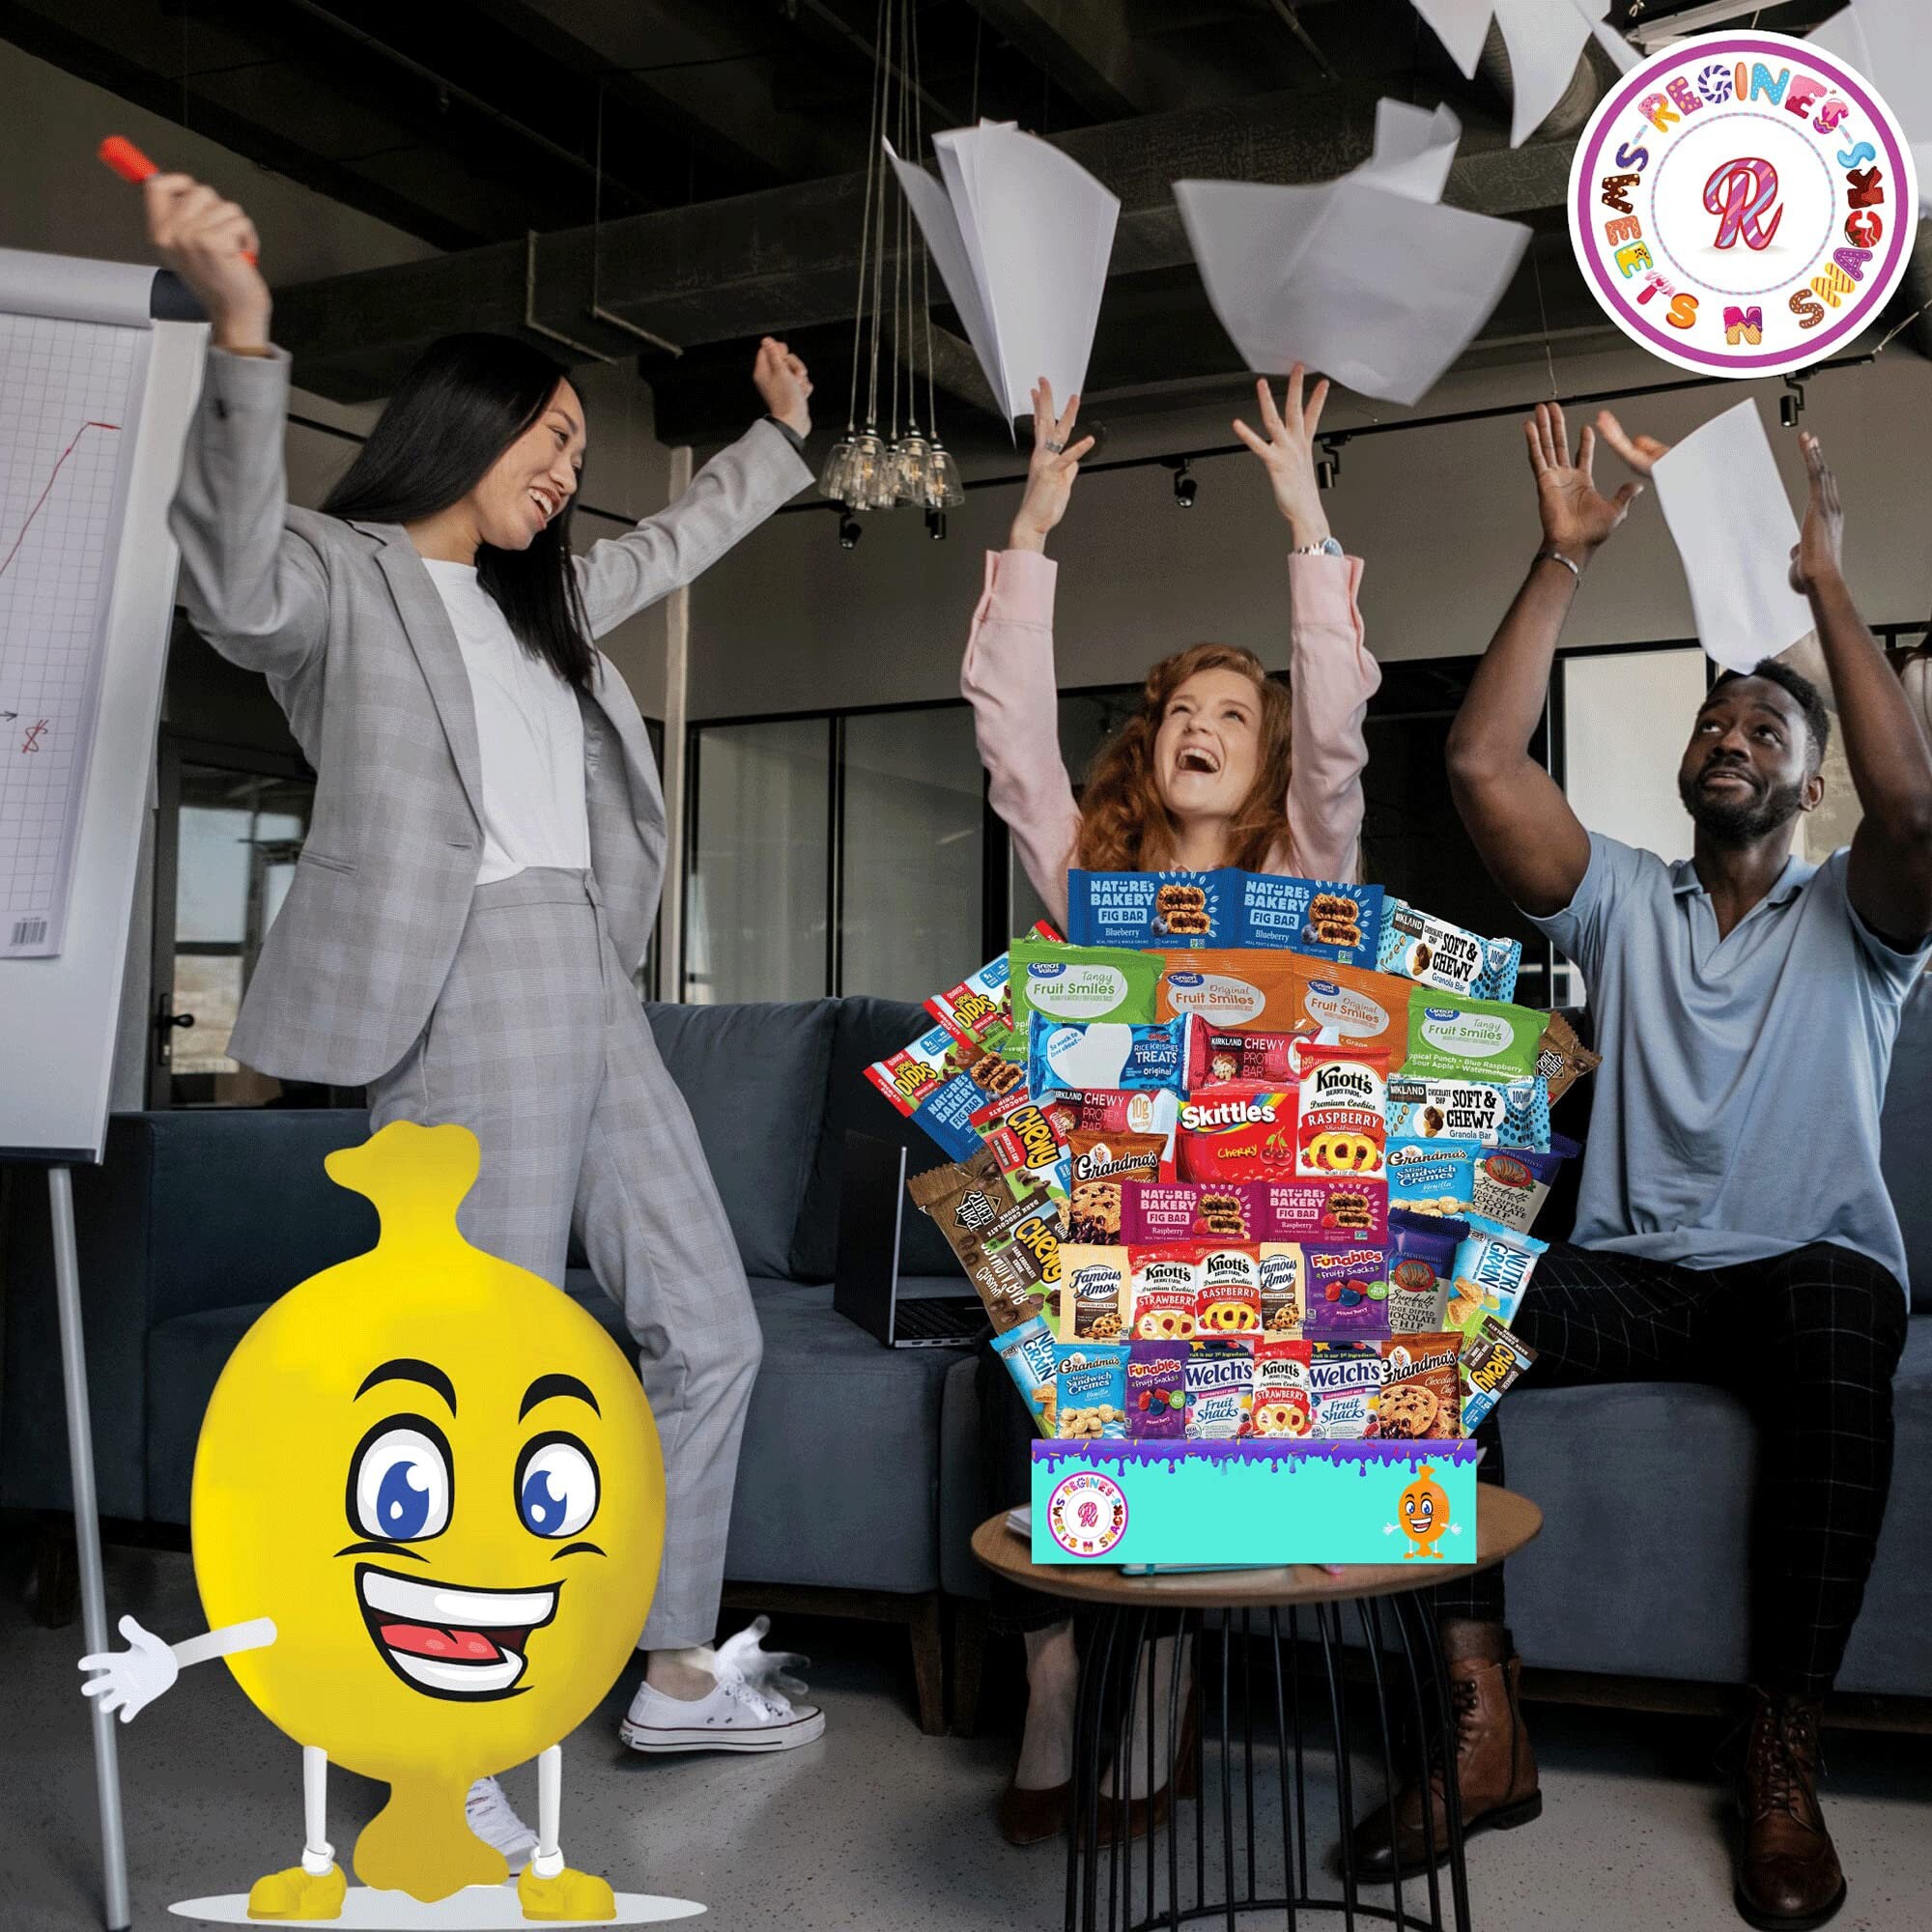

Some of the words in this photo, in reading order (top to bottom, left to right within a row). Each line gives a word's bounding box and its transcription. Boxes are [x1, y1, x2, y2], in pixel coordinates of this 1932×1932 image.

[21, 720, 49, 753] $
[1091, 894, 1153, 906] BAKERY
[1244, 894, 1309, 913] BAKERY
[1101, 911, 1119, 921] FIG
[1123, 911, 1144, 921] BAR
[1253, 912, 1272, 923] FIG
[1272, 915, 1295, 927] BAR
[1105, 927, 1140, 938] Blueberry
[1255, 929, 1290, 943] Blueberry
[1440, 933, 1468, 958] SOFT
[1466, 943, 1478, 962] &
[1433, 952, 1474, 981] CHEWY
[1082, 971, 1113, 985] Tangy
[1432, 972, 1454, 988] Granola
[1455, 981, 1466, 993] Bar
[1034, 983, 1065, 995] Fruit
[1067, 983, 1116, 995] Smiles
[1210, 984, 1249, 996] Original
[1176, 992, 1206, 1004] Fruit
[1209, 993, 1255, 1006] Smiles
[1343, 997, 1378, 1013] Original
[952, 994, 997, 1029] DIPPS
[1311, 998, 1338, 1012] Fruit
[1340, 1005, 1379, 1024] Smiles
[1429, 1024, 1457, 1037] Fruit
[1460, 1027, 1502, 1040] Smiles
[1473, 1018, 1501, 1032] Tangy
[1150, 1043, 1179, 1053] KRISPIES
[1211, 1037, 1242, 1046] KIRKLAND
[1244, 1037, 1285, 1050] CHEWY
[1135, 1051, 1179, 1065] TREATS
[1432, 1061, 1454, 1069] Apple
[1434, 1054, 1457, 1064] Punch
[1464, 1058, 1482, 1066] Blue
[1483, 1061, 1523, 1073] Raspberry
[894, 1062, 937, 1096] DIPPS
[1243, 1065, 1264, 1078] BAR
[1316, 1065, 1373, 1094] Knott's
[935, 1081, 977, 1123] BAKERY
[1084, 1093, 1124, 1108] CHEWY
[1310, 1099, 1346, 1110] Premium
[1347, 1098, 1376, 1110] Cookies
[1452, 1090, 1483, 1109] SOFT
[1484, 1091, 1497, 1109] &
[952, 1110, 969, 1126] FIG
[966, 1098, 980, 1116] BAR
[1131, 1096, 1150, 1120] 10g
[1181, 1100, 1276, 1130] Skittles
[1308, 1112, 1379, 1128] RASPBERRY
[1446, 1110, 1495, 1129] CHEWY
[1449, 1129, 1478, 1139] Granola
[1479, 1131, 1492, 1140] Bar
[1074, 1151, 1159, 1180] Grandma's
[1387, 1150, 1467, 1166] Grandma's
[1396, 1164, 1456, 1179] Sandwich
[1399, 1173, 1454, 1187] Cremes
[1141, 1200, 1197, 1210] BAKERY
[1270, 1198, 1325, 1208] BAKERY
[1472, 1201, 1511, 1218] CHIP
[1495, 1197, 1525, 1211] DIPPED
[1168, 1214, 1187, 1223] BAR
[1279, 1209, 1294, 1218] FIG
[1296, 1209, 1316, 1218] BAR
[1152, 1227, 1184, 1236] Raspberry
[1208, 1254, 1250, 1274] Knott's
[1312, 1250, 1383, 1268] Funables
[1477, 1241, 1509, 1289] GRAIN
[1069, 1269, 1122, 1289] Famous
[1146, 1264, 1191, 1281] Knott's
[1321, 1269, 1345, 1279] Fruity
[1347, 1266, 1375, 1275] Snacks
[1498, 1247, 1531, 1295] NUTRI
[1262, 1272, 1294, 1290] Amos
[1073, 1283, 1115, 1299] Amos
[1202, 1287, 1255, 1298] RASPBERRY
[1139, 1295, 1195, 1307] STRAWBERRY
[1408, 1308, 1435, 1317] DIPPED
[1390, 1319, 1424, 1329] CHIP
[1024, 1339, 1057, 1381] GRAIN
[1058, 1356, 1121, 1375] Grandma's
[1380, 1350, 1456, 1385] Grandma's
[1128, 1359, 1181, 1378] Funables
[1185, 1361, 1253, 1386] Welch's
[1262, 1360, 1300, 1378] Knott's
[1310, 1362, 1380, 1387] Welch's
[1066, 1372, 1112, 1387] Sandwich
[1068, 1380, 1110, 1395] Cremes
[1154, 1376, 1176, 1384] Snacks
[1256, 1390, 1304, 1401] STRAWBERRY
[1206, 1397, 1235, 1411] Fruit
[1331, 1398, 1360, 1411] Fruit
[1196, 1406, 1239, 1423] Snacks
[1321, 1409, 1366, 1424] Snacks
[1078, 1502, 1098, 1527] R
